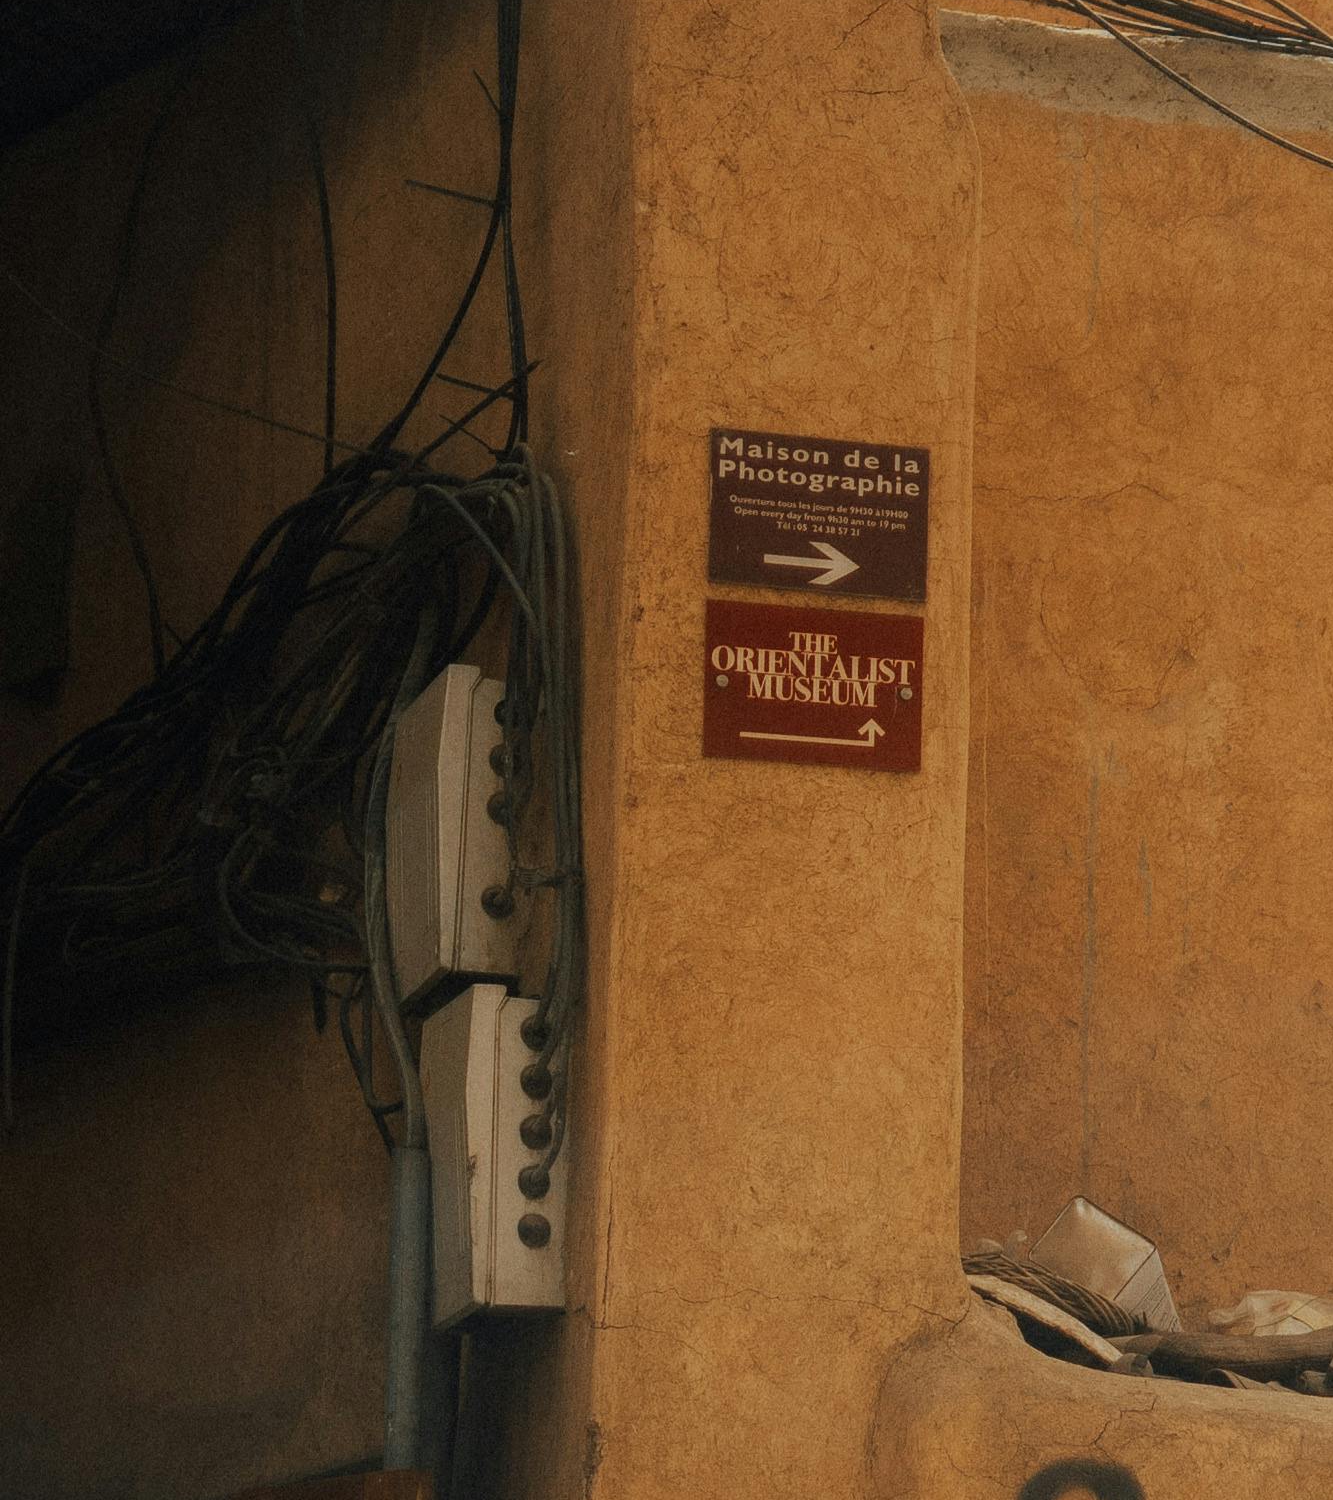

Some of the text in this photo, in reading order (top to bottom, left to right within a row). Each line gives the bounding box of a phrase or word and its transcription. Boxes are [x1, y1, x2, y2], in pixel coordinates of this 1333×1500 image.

[719, 436, 921, 474] Maison de la
[718, 459, 921, 497] Photographie
[729, 494, 776, 507] Ouverture
[777, 499, 797, 509] tous
[798, 501, 811, 510] les
[812, 502, 835, 514] jours
[836, 504, 848, 514] de
[849, 506, 874, 516] 9H30
[734, 506, 906, 532] Open every day from 9h30 am to 19 pm
[812, 524, 823, 533] 24
[838, 526, 848, 536] 57
[850, 528, 860, 537] 21
[788, 631, 838, 655] THE
[711, 644, 916, 686] ORIENTALIST
[746, 673, 878, 708] MUSEUM
